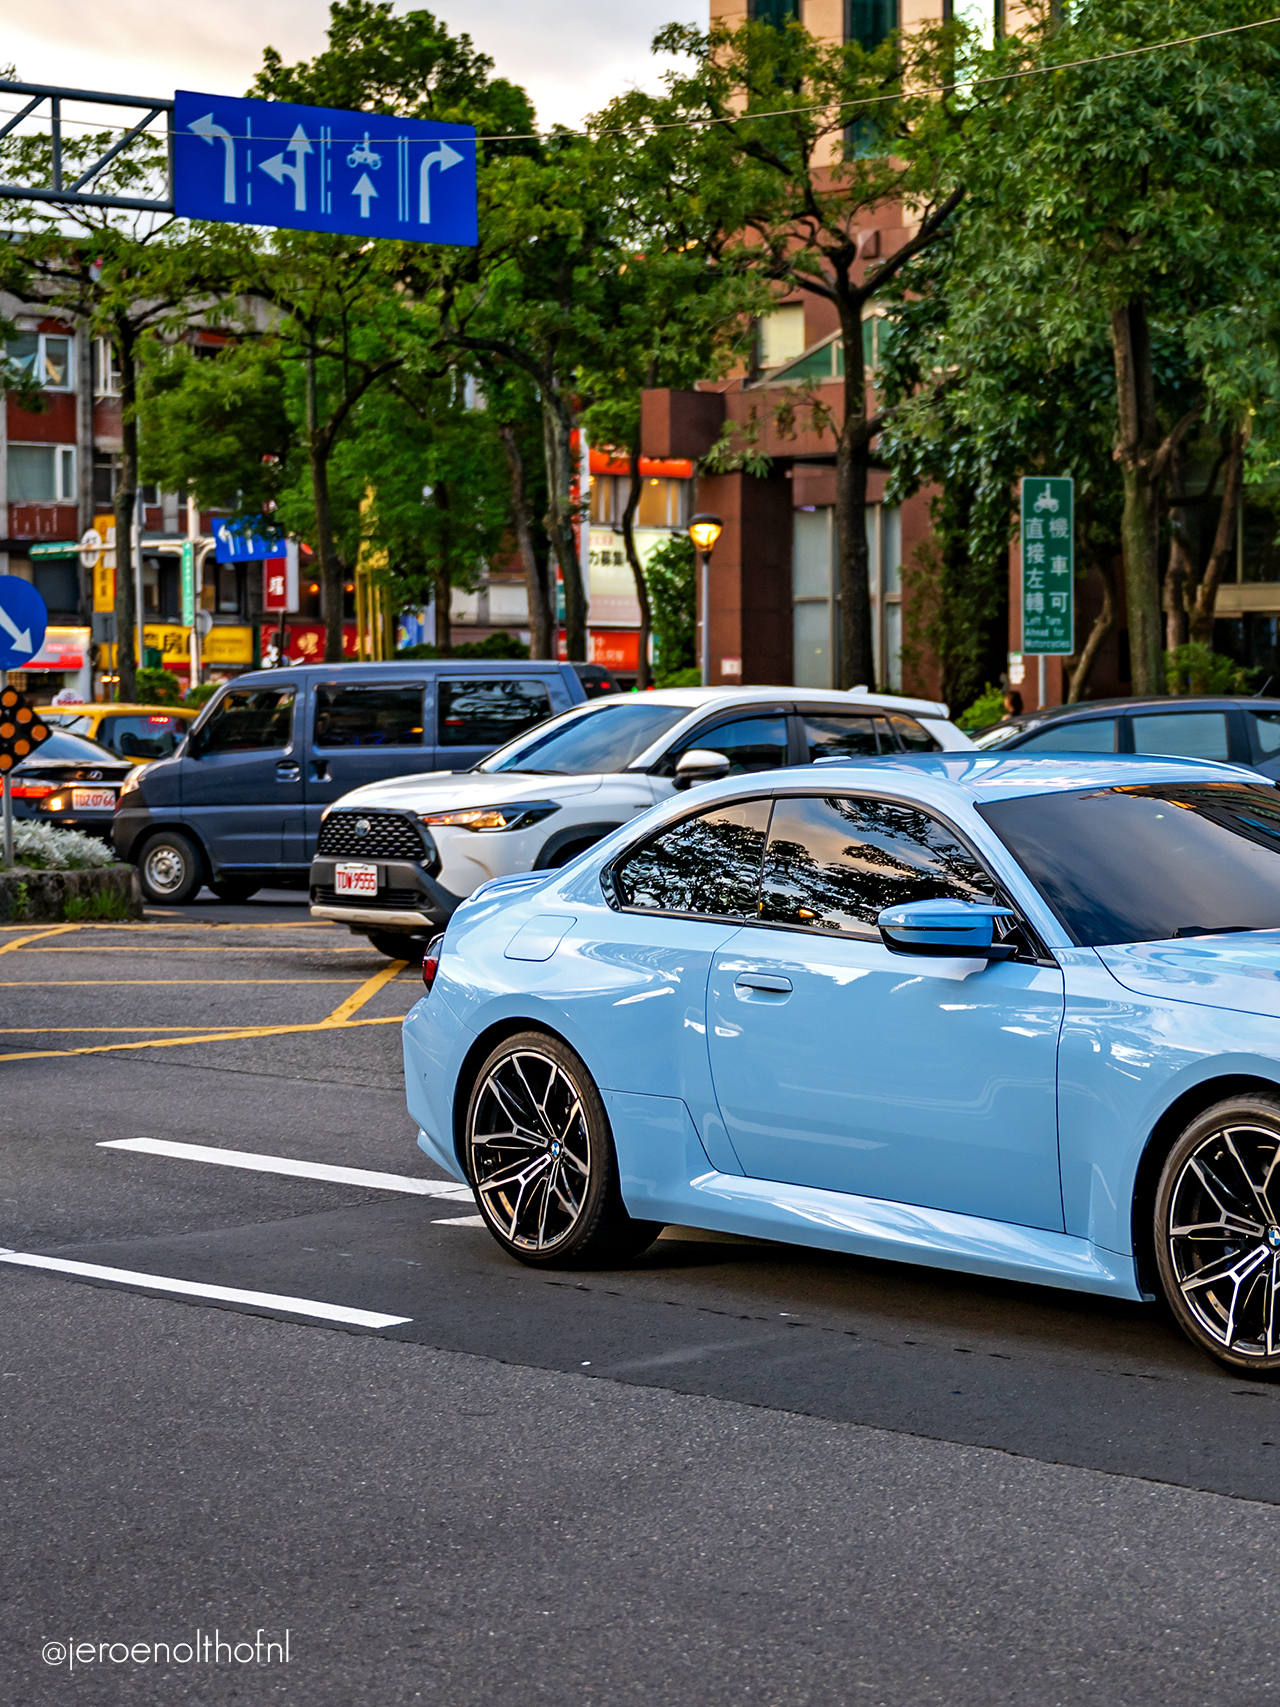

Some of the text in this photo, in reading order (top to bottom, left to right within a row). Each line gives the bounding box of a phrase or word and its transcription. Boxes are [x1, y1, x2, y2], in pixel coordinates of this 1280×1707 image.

[1025, 517, 1045, 614] 直接左轉
[1049, 517, 1069, 613] 機車可
[1025, 628, 1049, 637] Ahead
[1025, 639, 1070, 650] Motorcycles
